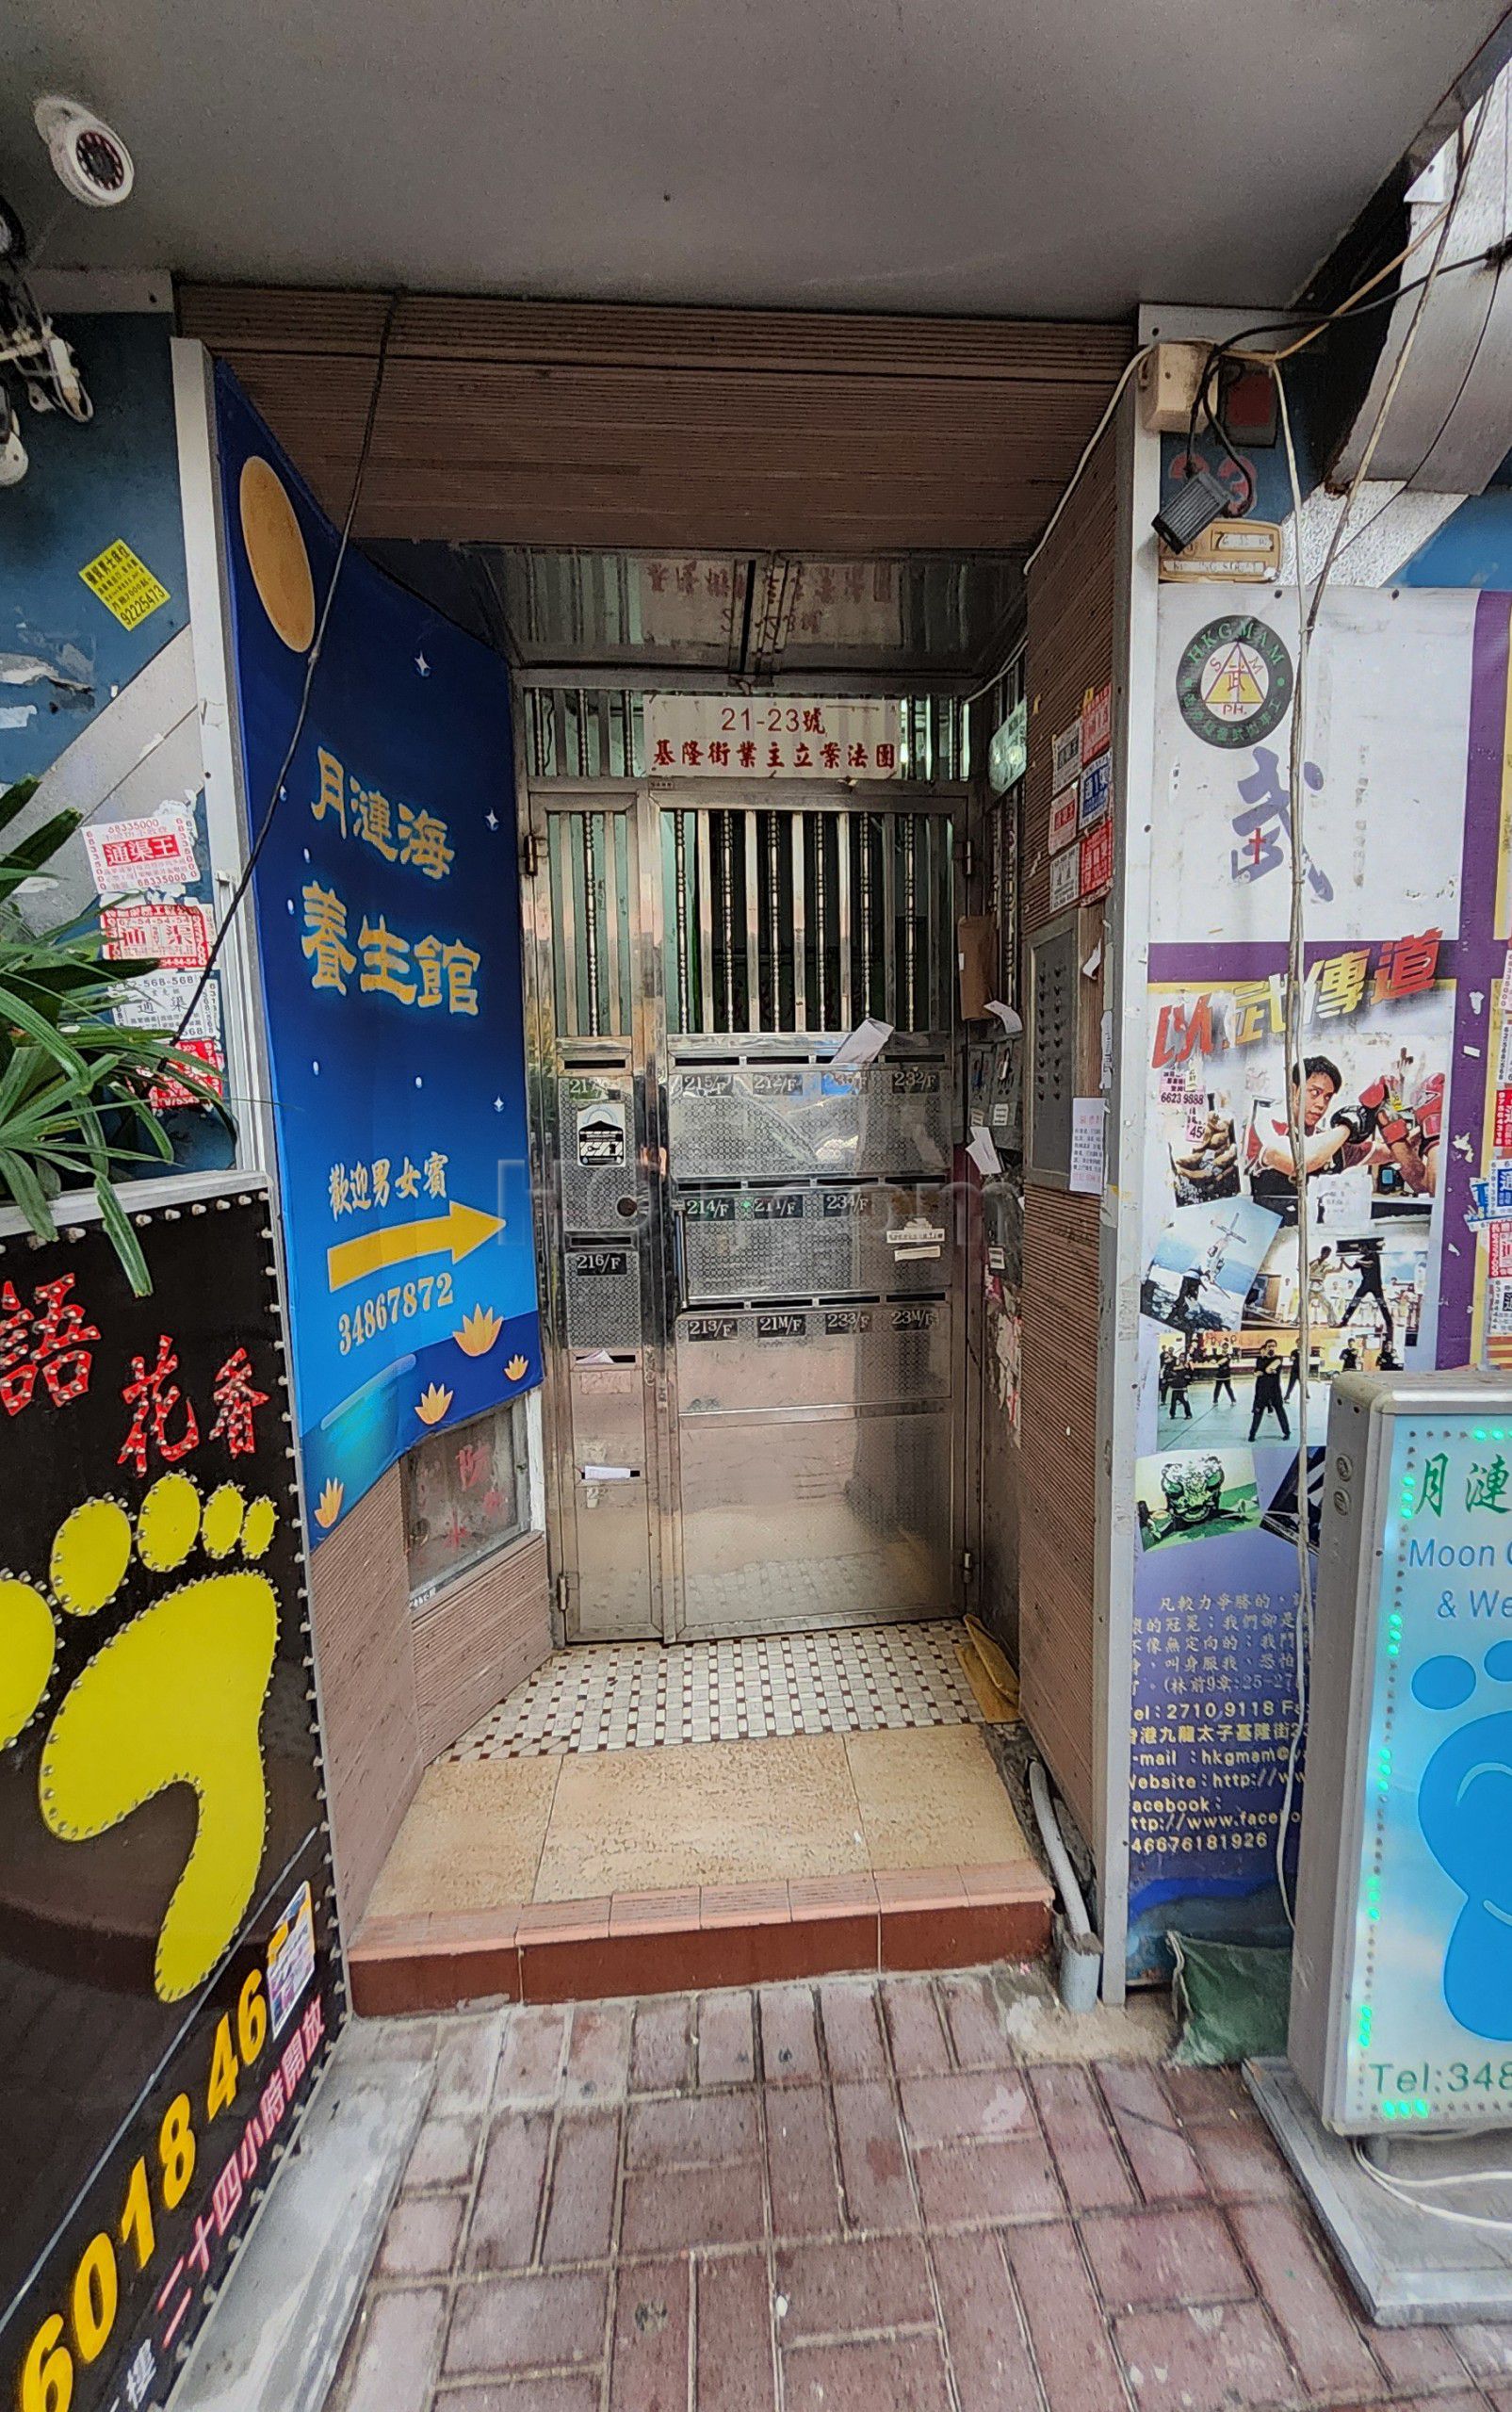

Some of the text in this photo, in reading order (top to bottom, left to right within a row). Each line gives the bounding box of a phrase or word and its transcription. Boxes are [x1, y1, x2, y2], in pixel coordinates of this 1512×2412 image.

[120, 584, 166, 626] 92225473
[1187, 622, 1285, 665] HKGMAM
[721, 707, 826, 735] 21-23號
[653, 739, 895, 769] 基隆街業主立案法團
[1231, 746, 1334, 903] 武
[104, 836, 181, 866] 通渠王
[301, 880, 480, 1016] 養生館
[138, 996, 188, 1015] 通渠
[1151, 926, 1443, 1068] 以武傳道
[895, 1070, 936, 1088] 232/F
[1161, 1091, 1182, 1104] 6623
[328, 1150, 449, 1222] 歡迎男女賓
[686, 1198, 729, 1218] 214/F
[825, 1194, 869, 1214] 234/F
[577, 1253, 622, 1273] 216/F
[338, 1272, 454, 1356] 34867872
[689, 1319, 733, 1338] 213/F
[759, 1315, 803, 1335] 21M/F
[826, 1312, 870, 1333] 233/F
[1408, 1538, 1495, 1568] Moon
[1437, 1589, 1457, 1619] &
[1166, 1702, 1217, 1720] 2710
[1225, 1699, 1275, 1718] 9118
[156, 1994, 326, 2350] 二十四小時開放
